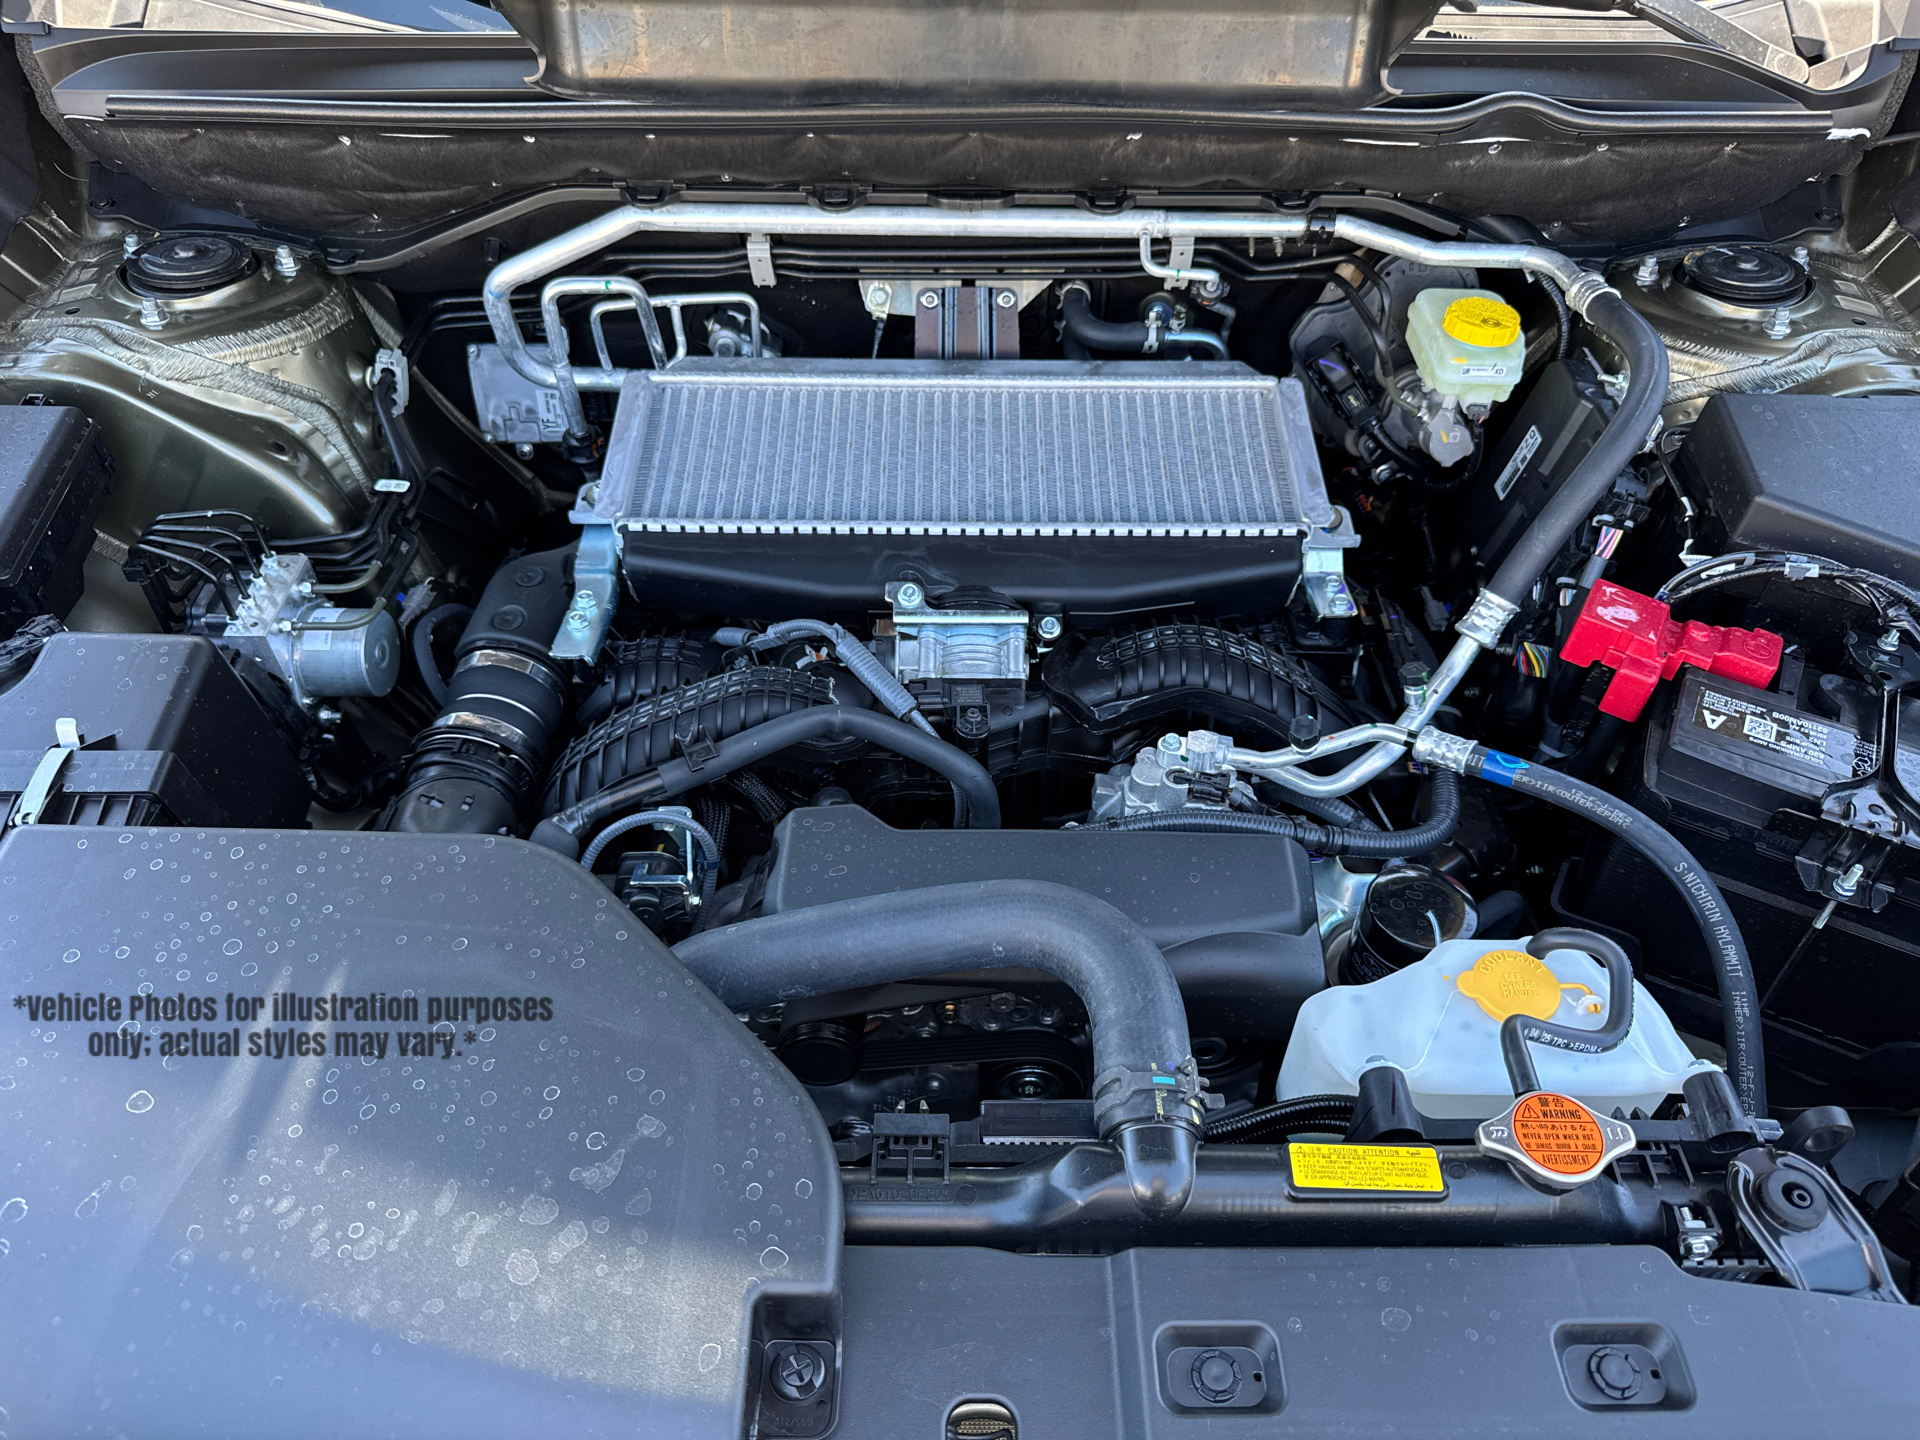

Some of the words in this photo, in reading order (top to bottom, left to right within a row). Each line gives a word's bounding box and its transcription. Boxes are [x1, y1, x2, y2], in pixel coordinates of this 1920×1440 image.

[1703, 709, 1728, 730] A
[1748, 736, 1768, 746] AMPS
[1779, 739, 1807, 753] AMPS
[1807, 736, 1826, 746] LN2
[1768, 742, 1803, 757] CRANKING
[1713, 925, 1744, 978] HYLAMMIT
[1478, 950, 1547, 973] COOLANT
[1502, 990, 1539, 998] MANUAL
[1540, 1109, 1581, 1120] WARNING
